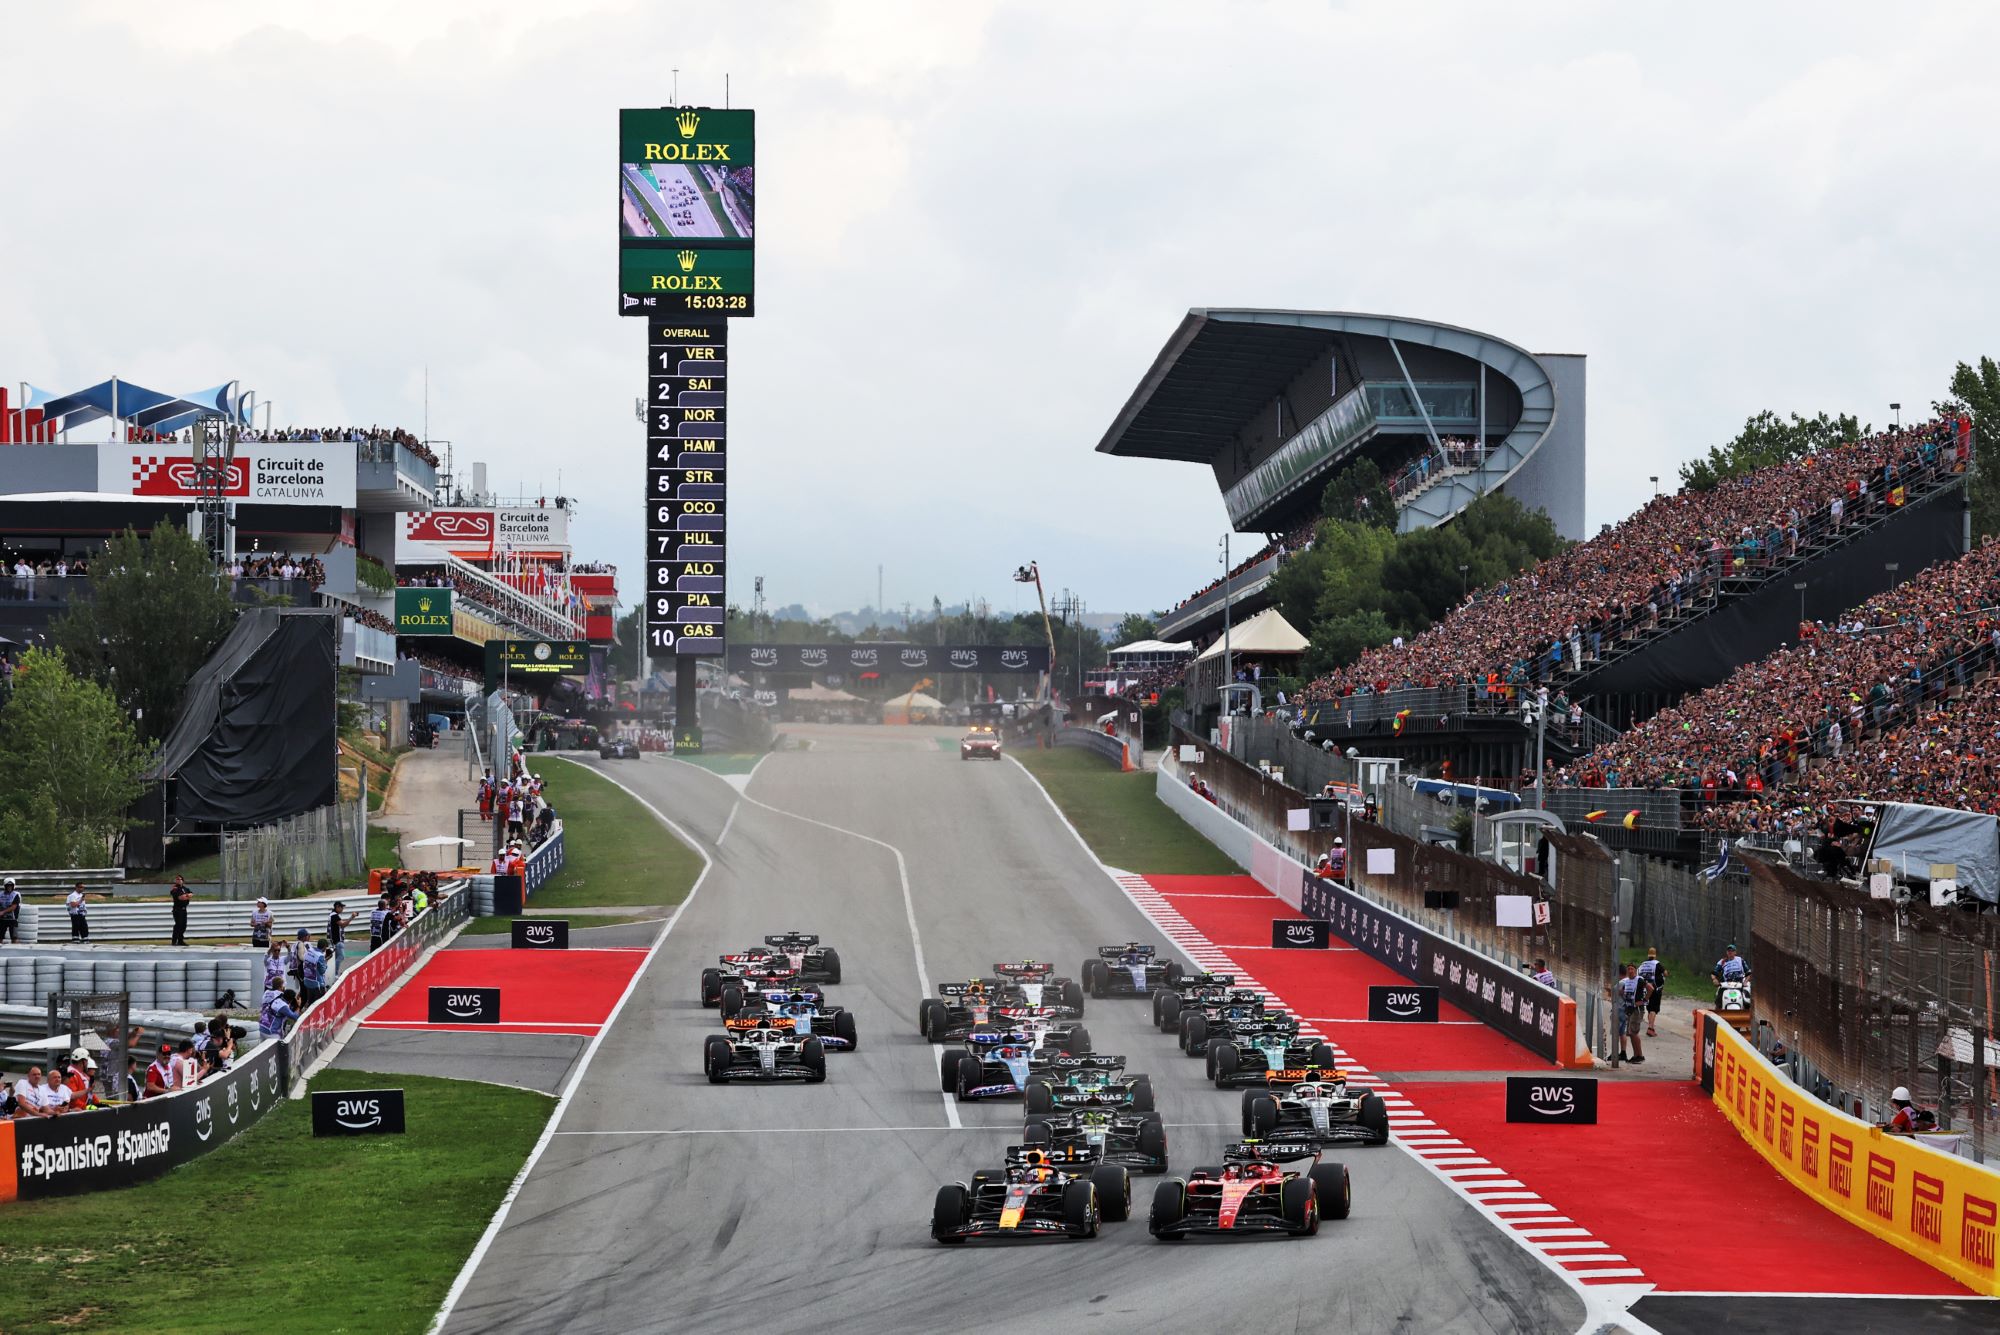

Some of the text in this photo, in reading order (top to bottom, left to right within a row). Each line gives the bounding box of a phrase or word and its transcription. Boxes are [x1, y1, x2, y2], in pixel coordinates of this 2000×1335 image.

[644, 144, 730, 160] ROLEX
[652, 276, 722, 290] ROLEX
[644, 296, 746, 308] NE 15:03:28
[663, 329, 710, 337] OVERALL
[659, 348, 714, 368] 1 VER
[658, 379, 711, 399] 2 SAI
[658, 410, 715, 430] 3 NOR
[658, 440, 715, 461] 4 HAM
[257, 458, 324, 471] Circuit de
[258, 473, 324, 484] Barcelona
[658, 471, 713, 492] 5 STR
[257, 488, 324, 498] CATALUNYA
[500, 513, 549, 522] Circuit de
[658, 502, 715, 522] 6 OCO
[500, 524, 549, 532] Barcelona
[500, 534, 550, 542] CATALUNYA
[658, 533, 713, 553] 7 HUL
[658, 563, 713, 584] 8 ALO
[657, 594, 710, 615] 9 PIA
[401, 615, 448, 625] ROLEX
[652, 625, 713, 646] 10 GAS
[751, 648, 777, 659] aws
[801, 649, 827, 659] aws
[851, 649, 877, 660] aws
[901, 649, 927, 660] aws
[951, 650, 977, 660] aws
[1001, 650, 1027, 660] aws
[526, 926, 553, 936] aws
[1287, 925, 1314, 936] aws
[448, 994, 481, 1006] aws
[1387, 992, 1420, 1005] aws
[1531, 1086, 1573, 1102] aws
[337, 1099, 380, 1115] aws
[22, 1135, 112, 1180] #SpanishGP
[117, 1122, 170, 1165] #SpanishGP
[196, 1096, 211, 1124] aws
[1802, 1116, 1819, 1179] PIRELLI
[1829, 1133, 1853, 1199] PIRELLI
[1867, 1151, 1895, 1221] PIRELLI
[1911, 1170, 1944, 1244] PIRELLI
[1961, 1192, 1997, 1269] PIRELLI
